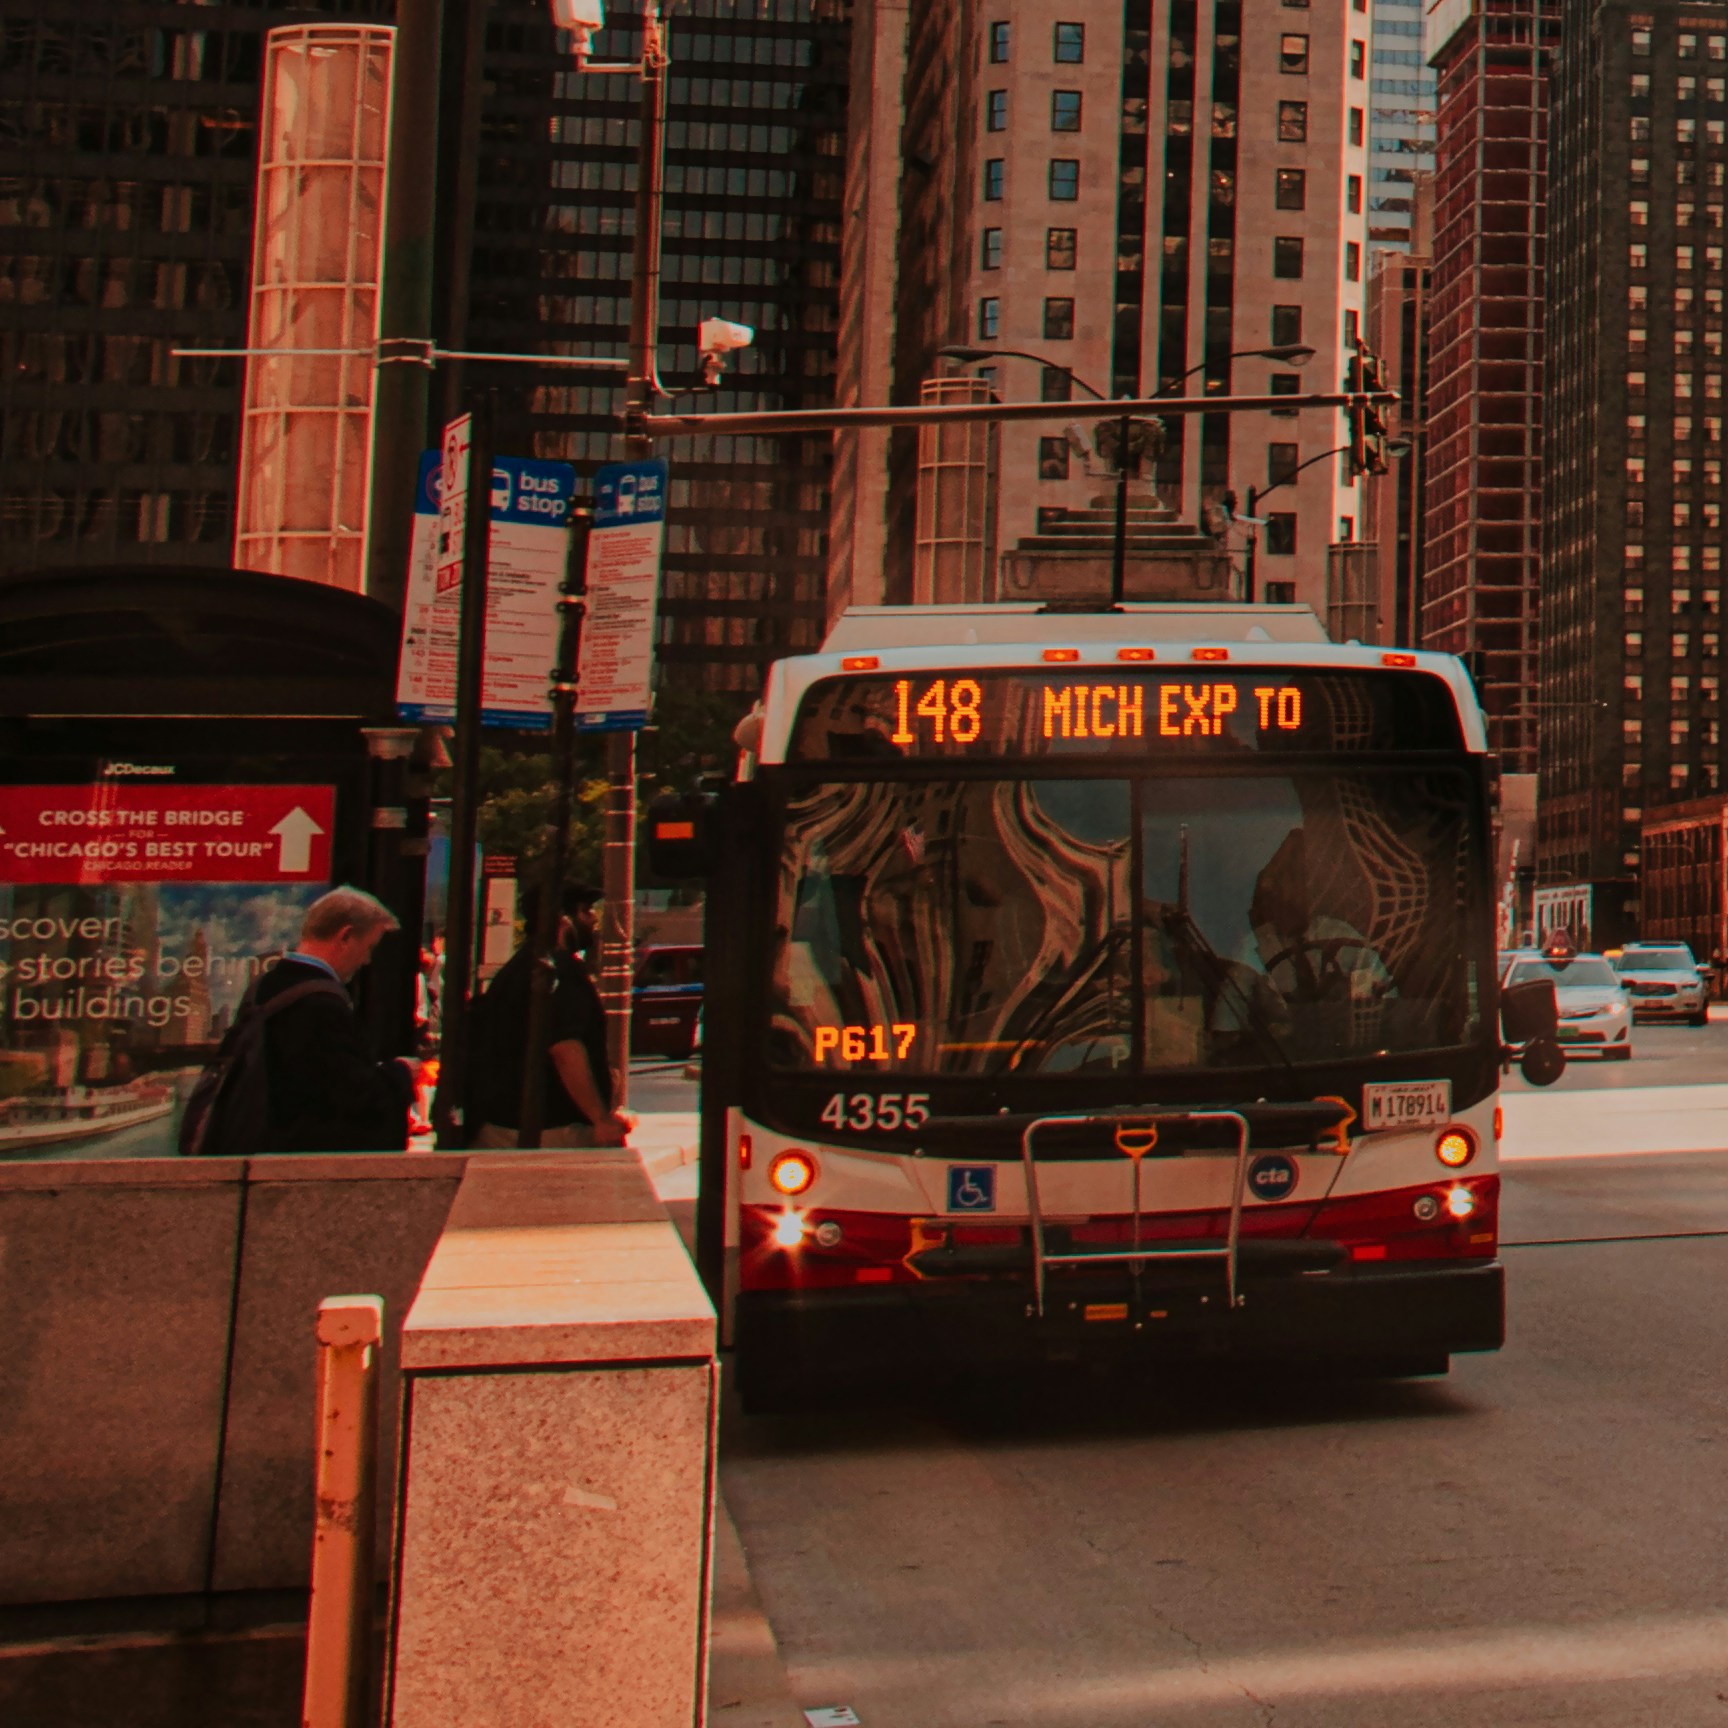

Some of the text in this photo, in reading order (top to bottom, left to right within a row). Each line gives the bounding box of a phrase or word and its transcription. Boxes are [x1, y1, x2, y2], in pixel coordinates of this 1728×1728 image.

[520, 472, 559, 492] bus
[517, 496, 566, 518] stop
[891, 679, 1302, 744] 148 MICH EXP TO
[104, 763, 175, 775] JCDecaux
[38, 810, 244, 825] CROSS THE BRIDGE
[145, 842, 197, 857] BEST
[84, 860, 193, 871] CHICAGO READER
[17, 949, 147, 980] stories
[815, 1024, 916, 1062] P617
[821, 1093, 930, 1131] 4355
[1387, 1092, 1446, 1117] 178914
[1255, 1168, 1291, 1184] cta
